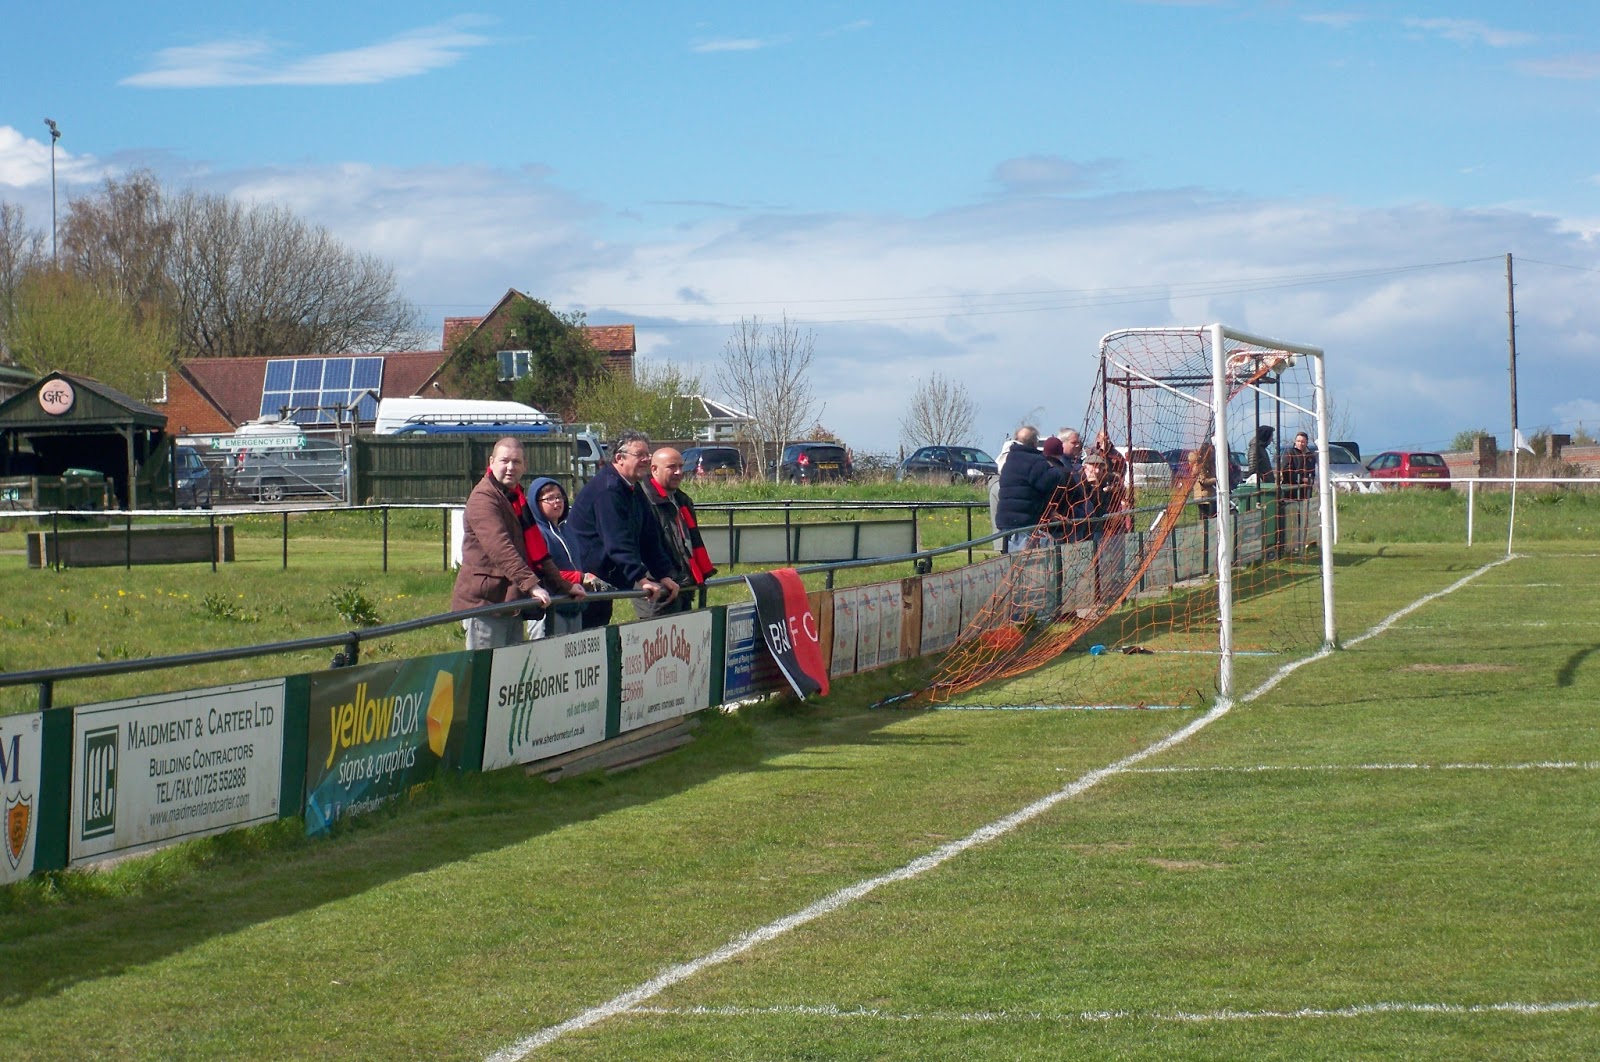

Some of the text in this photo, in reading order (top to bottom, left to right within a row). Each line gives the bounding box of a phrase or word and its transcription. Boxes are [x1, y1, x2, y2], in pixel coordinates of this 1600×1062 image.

[225, 437, 293, 447] EMERGENCY EXIT
[643, 625, 669, 675] Radio
[670, 623, 691, 666] Cabs
[498, 664, 601, 708] SHERBORNE TURF
[127, 719, 193, 751] MAIDMENT
[195, 717, 204, 738] &
[531, 726, 585, 748] www.sherborneturf.co.uk
[149, 743, 255, 778] BUILDING CONTRACTORS
[338, 741, 417, 790] signs & graphics
[156, 776, 194, 805] TEL/FAX:
[194, 772, 218, 797] 01725
[149, 792, 250, 827] www.maidmentandcarter.com
